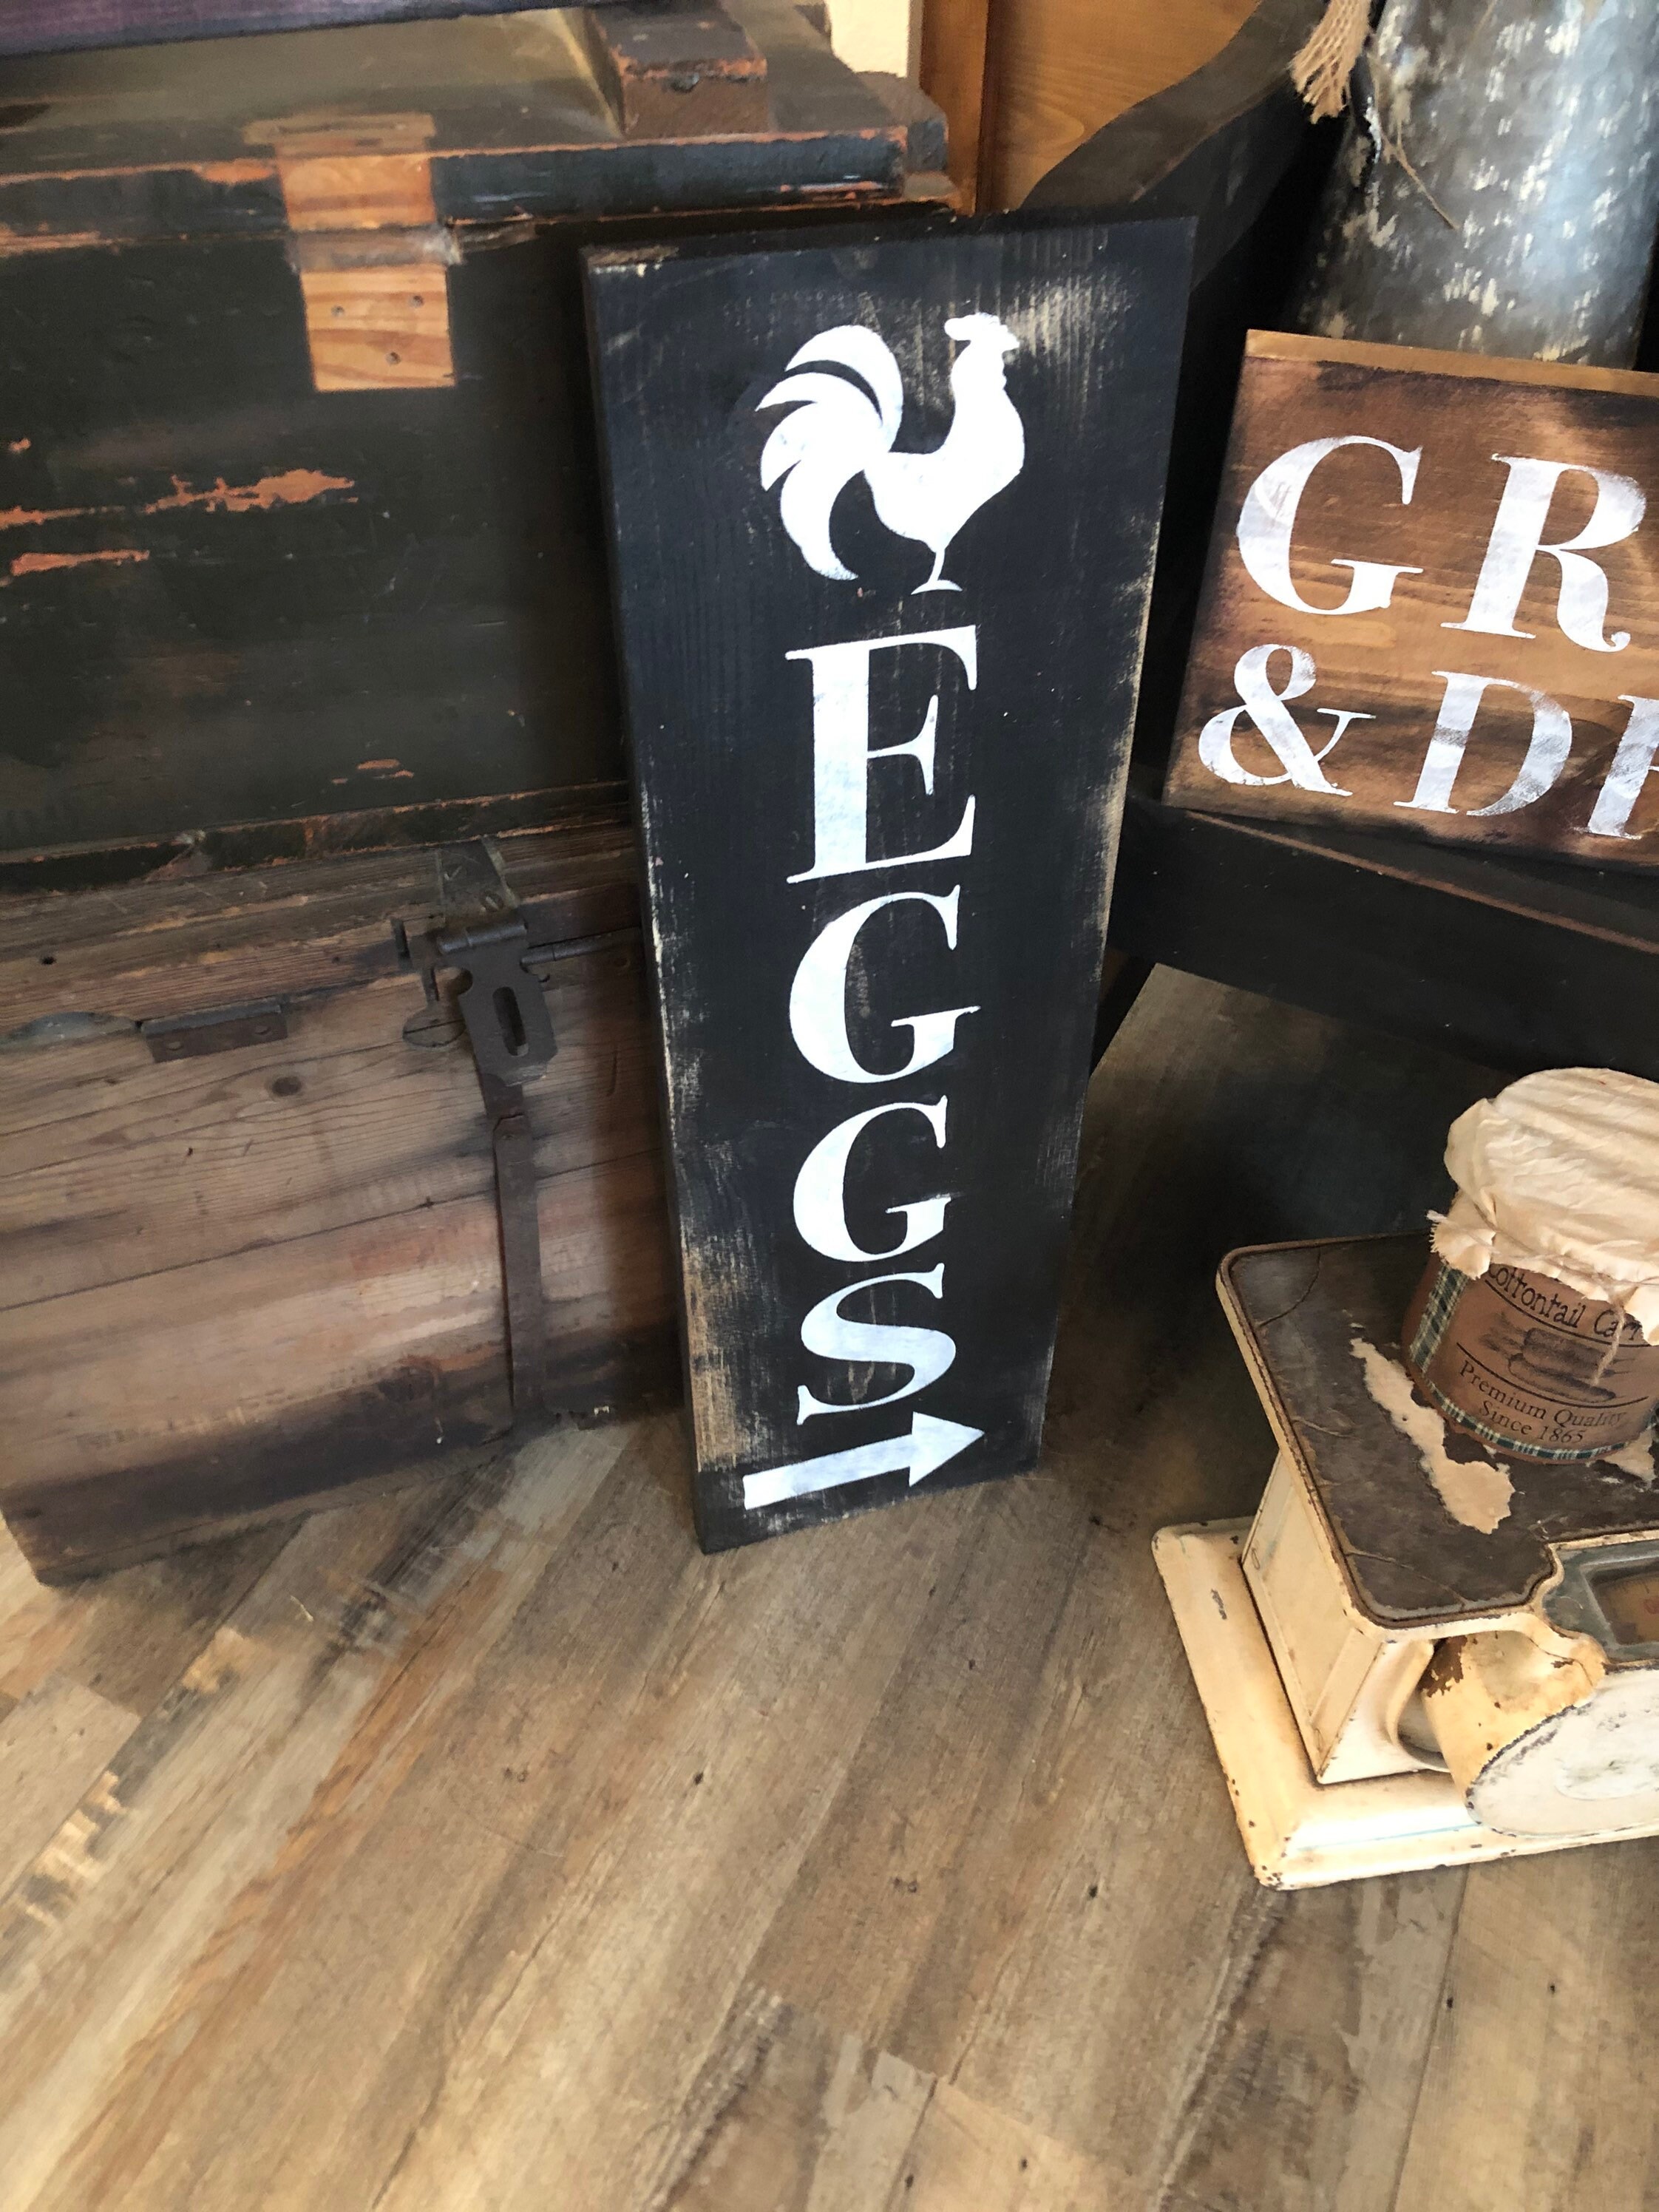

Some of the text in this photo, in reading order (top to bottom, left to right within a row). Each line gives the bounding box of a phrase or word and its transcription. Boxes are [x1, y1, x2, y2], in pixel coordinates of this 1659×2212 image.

[1198, 643, 1377, 798] &
[785, 625, 980, 1425] EGGS
[1459, 1359, 1627, 1428] Premium Quality
[1480, 1400, 1587, 1443] Since 1865
